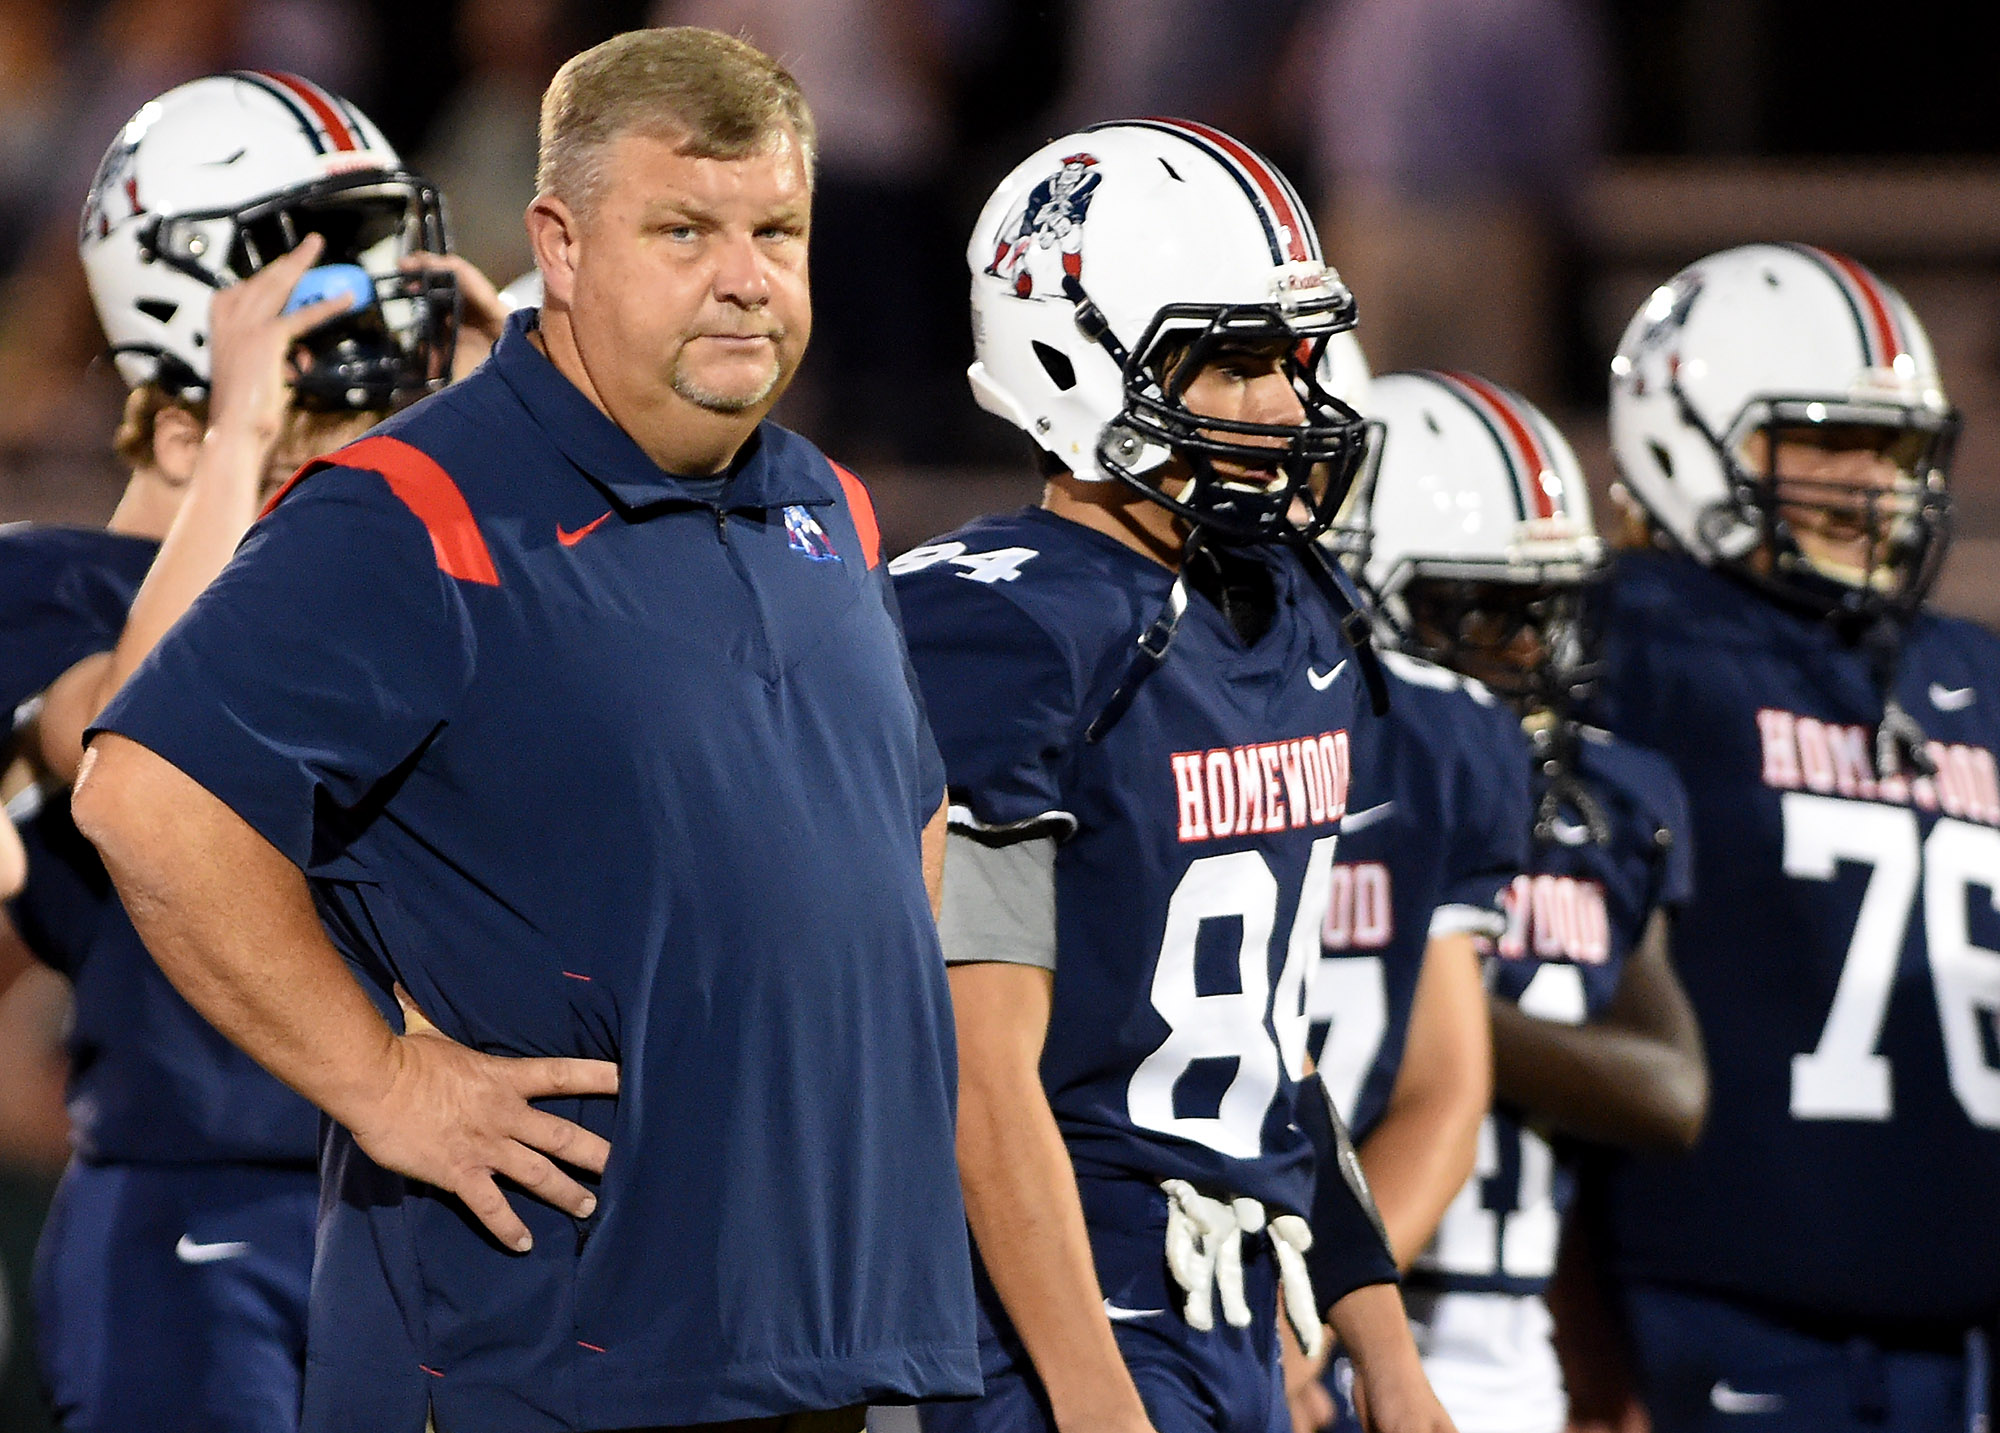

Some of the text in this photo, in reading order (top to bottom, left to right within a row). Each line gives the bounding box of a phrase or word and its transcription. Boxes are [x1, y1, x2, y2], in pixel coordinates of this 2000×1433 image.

[1170, 728, 1350, 843] HOMEWOOD
[1756, 706, 2000, 827] HOMOOD
[1781, 791, 2000, 1131] 76
[1303, 954, 1389, 1132] 7
